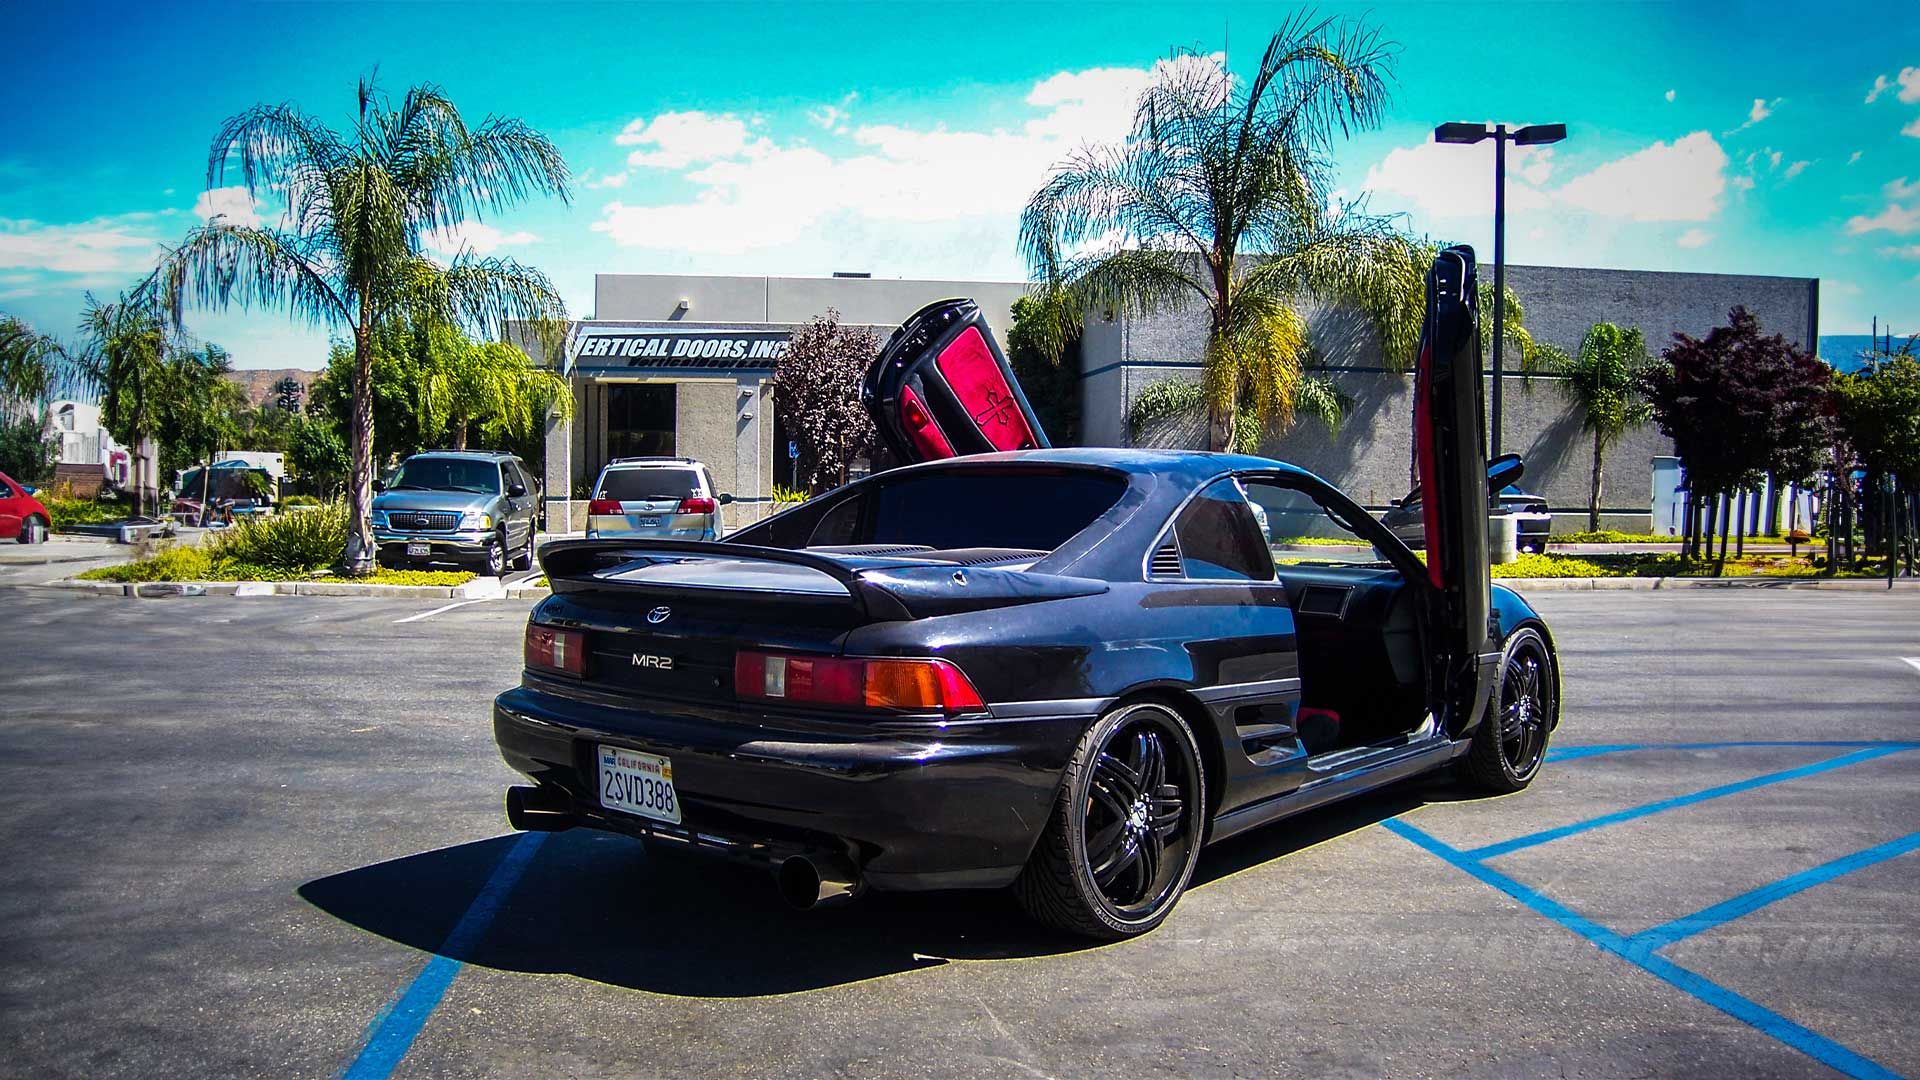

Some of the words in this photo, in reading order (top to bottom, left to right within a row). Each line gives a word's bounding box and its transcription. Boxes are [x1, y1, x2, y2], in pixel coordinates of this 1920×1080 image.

[632, 654, 672, 669] MR2
[618, 756, 660, 774] CALIFORNIA
[605, 770, 674, 813] 2SVD388
